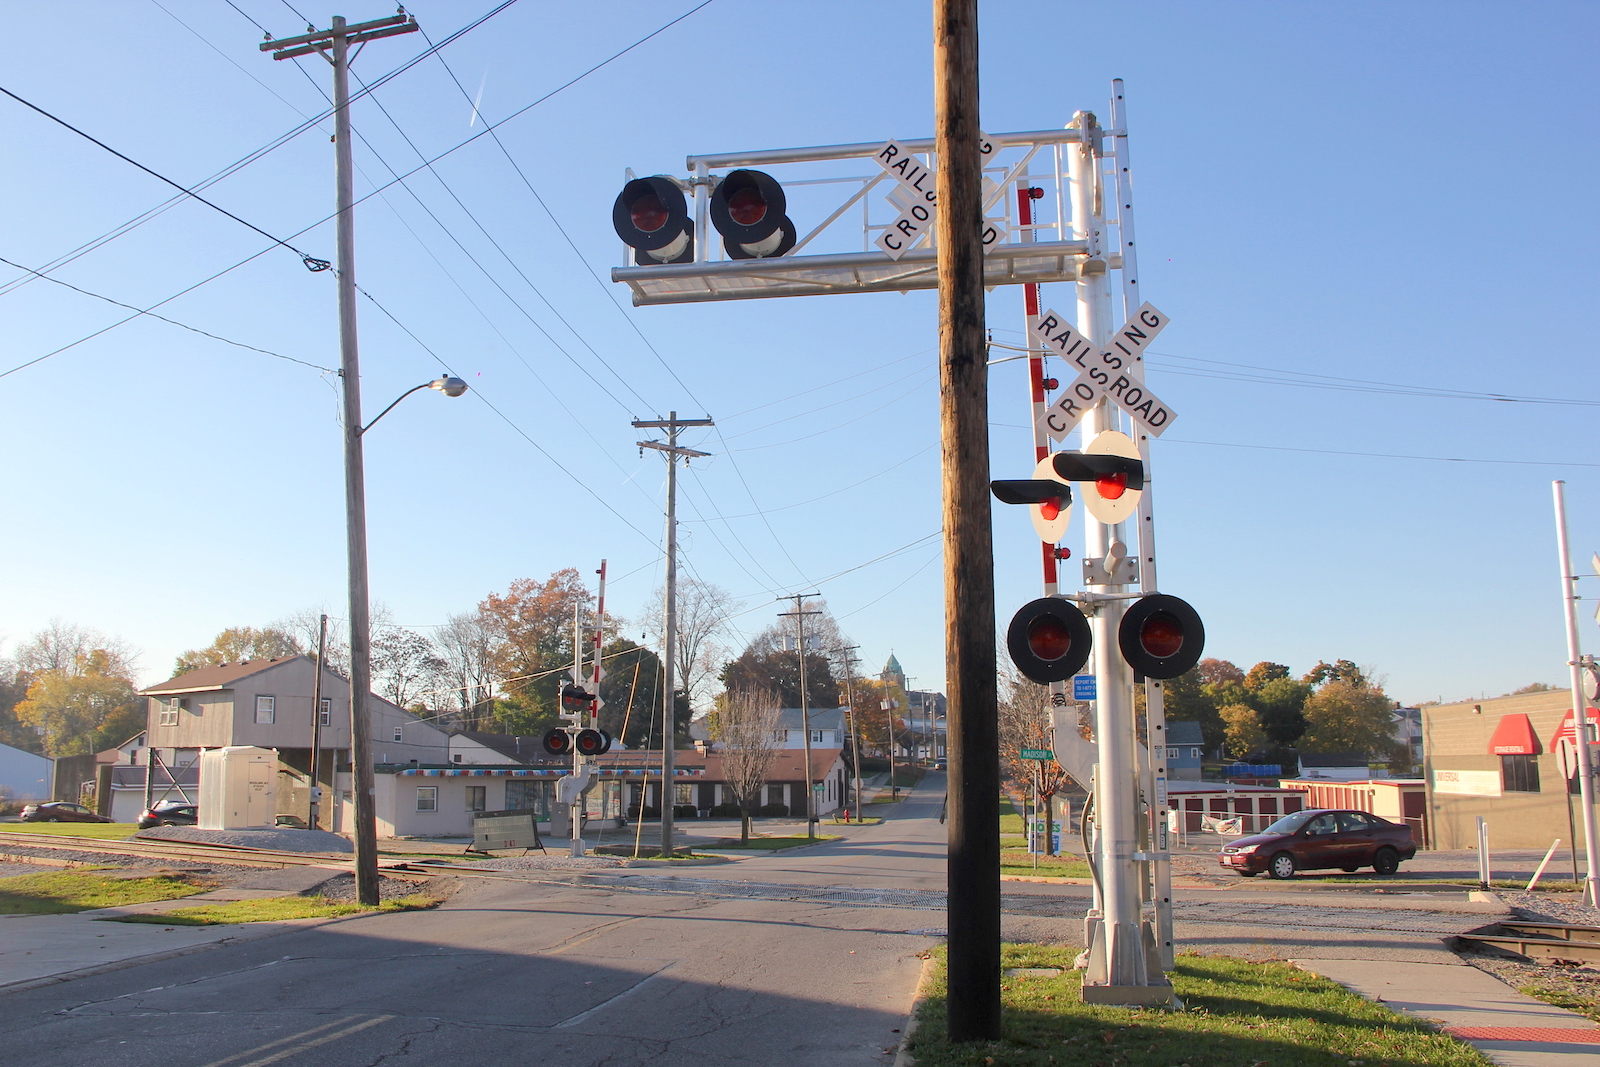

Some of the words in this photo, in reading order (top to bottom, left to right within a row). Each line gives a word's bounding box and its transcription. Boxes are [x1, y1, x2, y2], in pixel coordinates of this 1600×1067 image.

[1038, 315, 1090, 368] RAIL
[1109, 375, 1168, 427] ROAD
[1046, 310, 1160, 432] CROSSING
[1022, 750, 1046, 759] MADISON
